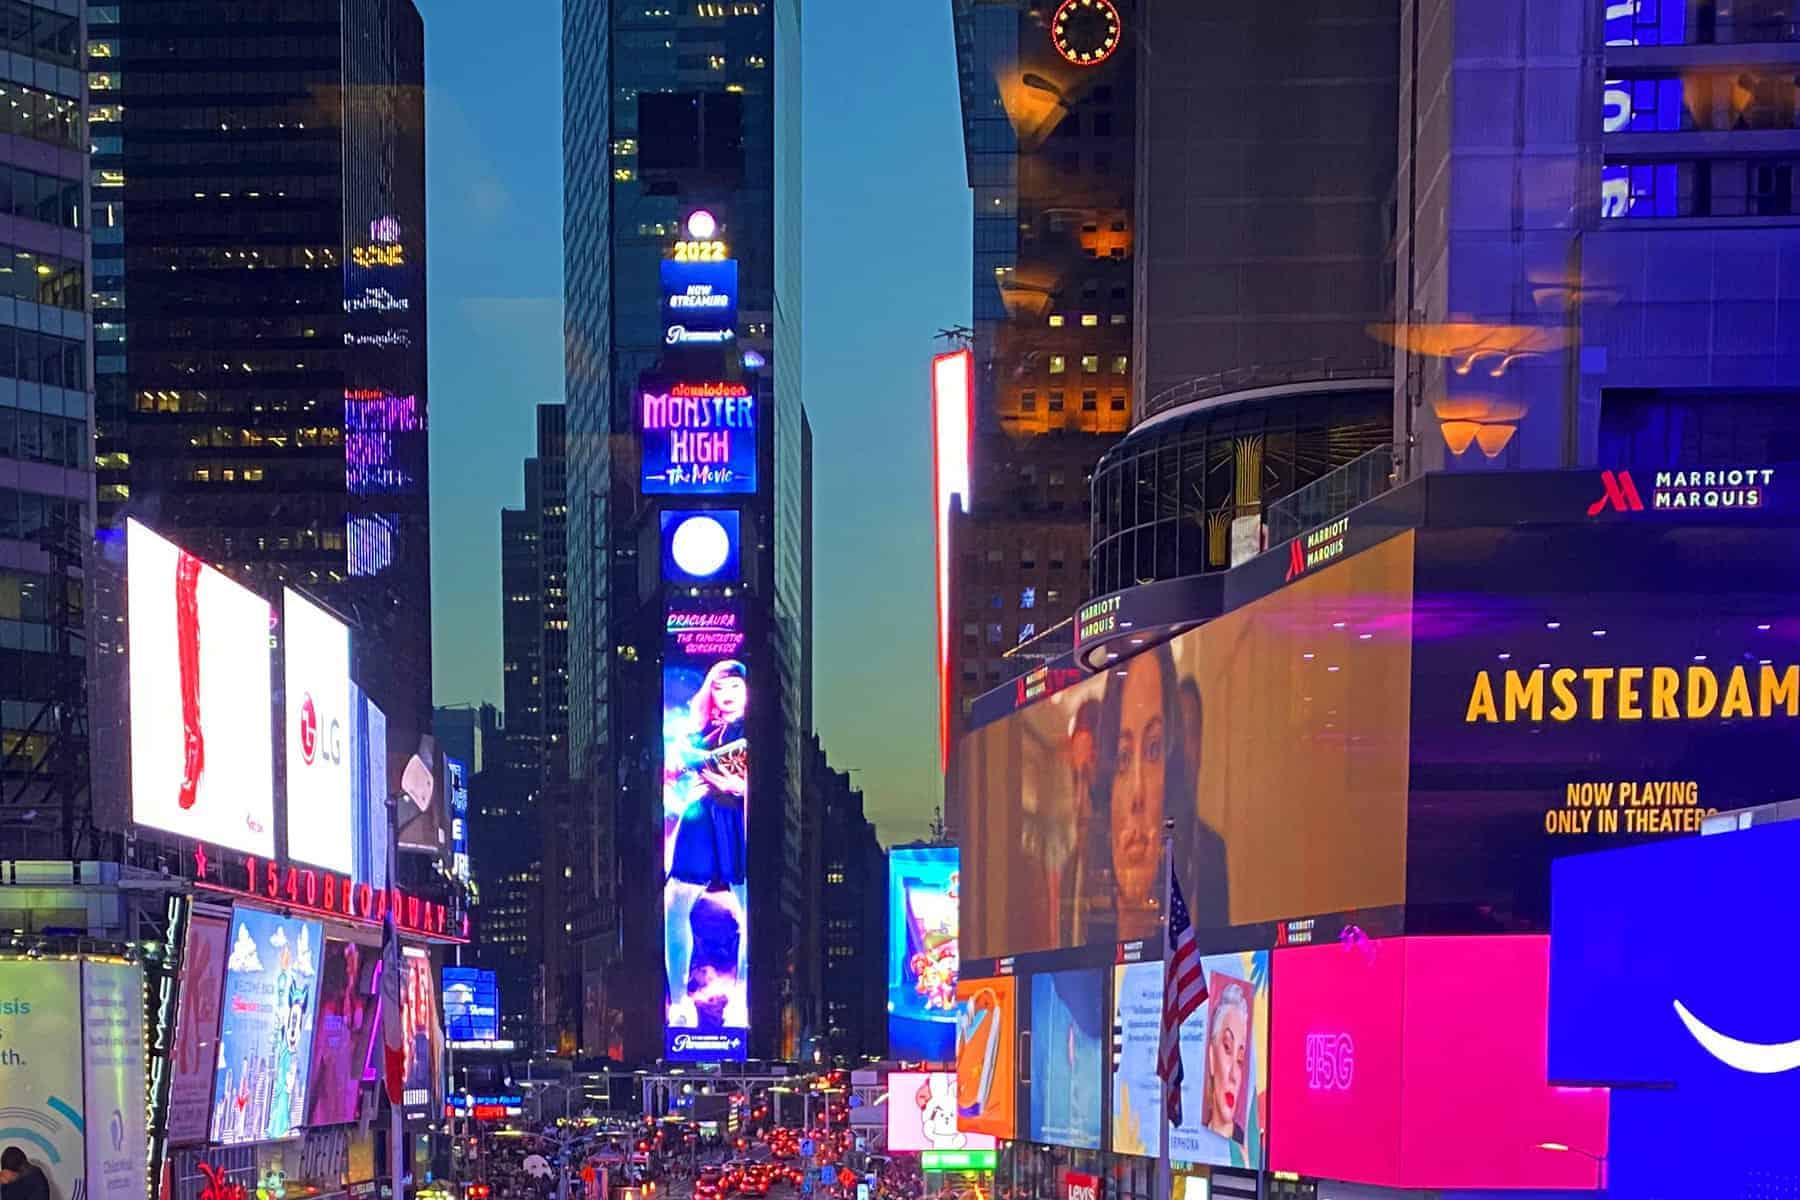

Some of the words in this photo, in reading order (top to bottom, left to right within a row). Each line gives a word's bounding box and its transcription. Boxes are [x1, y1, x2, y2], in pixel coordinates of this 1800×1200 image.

[674, 241, 728, 263] 2022
[687, 284, 713, 296] NOW
[643, 393, 753, 429] MONSTER
[670, 429, 729, 464] HIGH
[666, 464, 690, 486] The
[691, 463, 733, 486] Movie
[1655, 469, 1775, 488] MARRIOTT
[1655, 490, 1759, 508] MARQUIS
[1307, 516, 1350, 549] MARRIOTT
[1307, 538, 1344, 568] MARQUIS
[666, 613, 736, 628] DRACULAURA
[1465, 664, 1800, 723] AMSTERDAM
[1566, 783, 1614, 807] NOW
[1619, 781, 1699, 806] PLAYING
[1545, 809, 1593, 834] ONLY
[1598, 808, 1618, 834] IN
